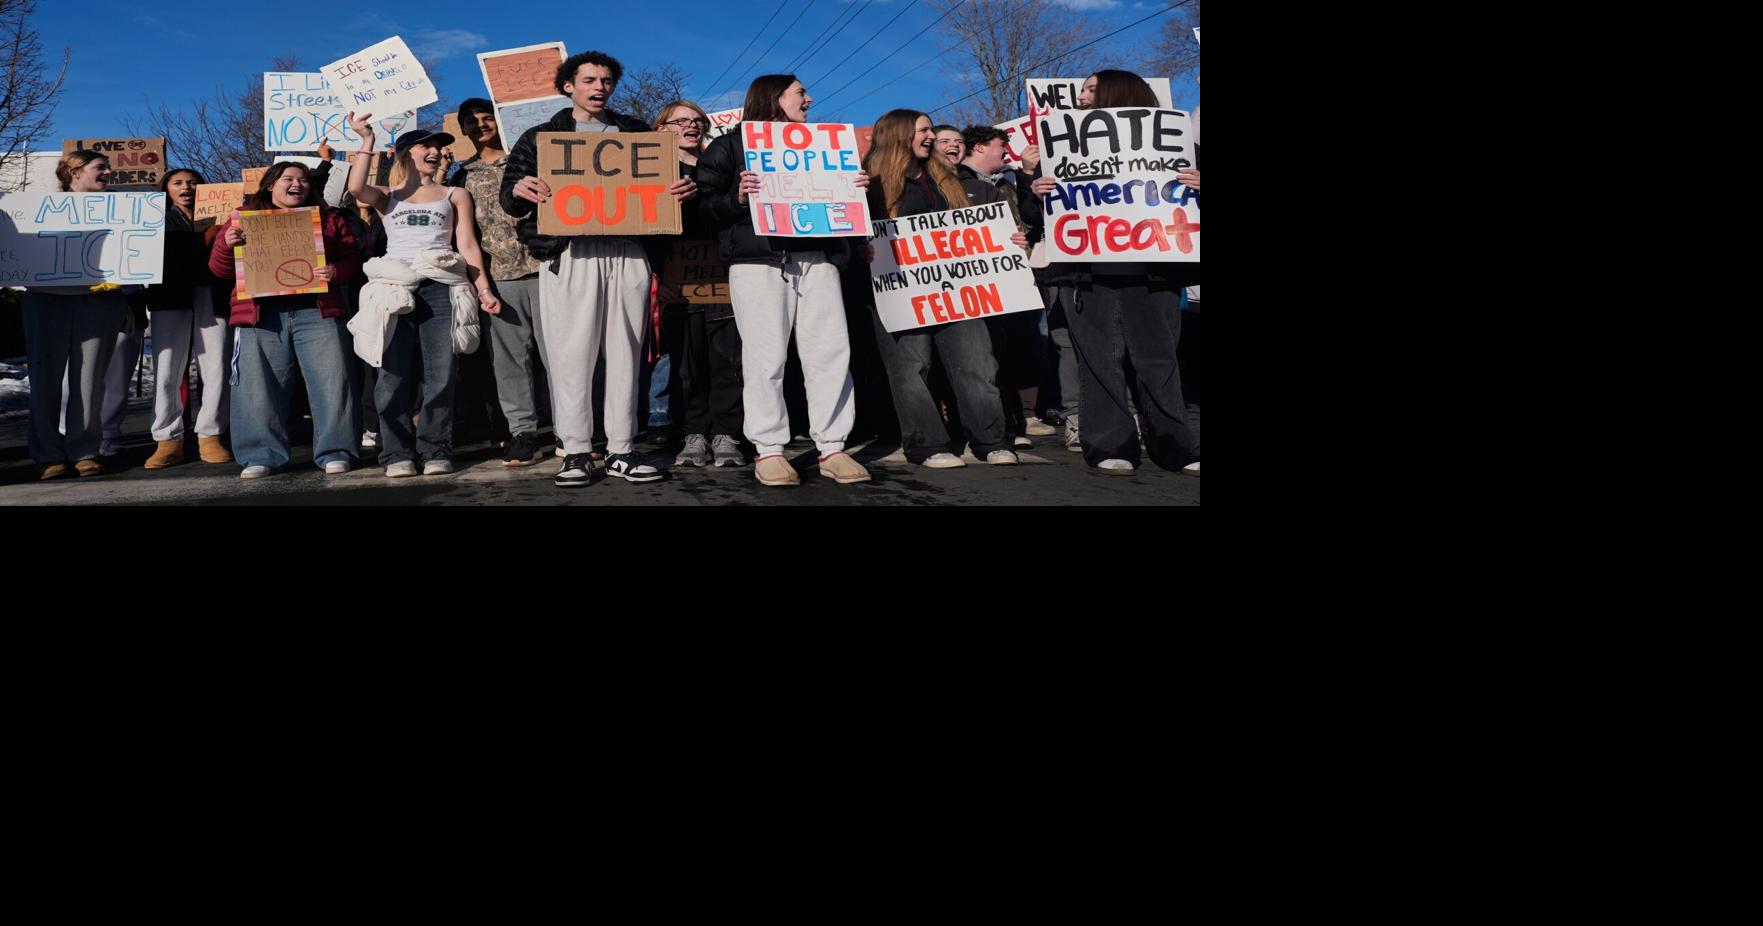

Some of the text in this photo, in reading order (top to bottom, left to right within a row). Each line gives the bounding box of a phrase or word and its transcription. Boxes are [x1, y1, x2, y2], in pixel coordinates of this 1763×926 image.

[269, 74, 296, 91] I
[334, 60, 367, 79] ICE
[353, 88, 376, 105] NOT
[268, 115, 308, 147] NO
[745, 122, 847, 150] HOT
[1040, 109, 1185, 159] HATE
[117, 152, 160, 167] NO
[551, 138, 661, 178] ICE
[745, 149, 858, 172] PEOPLE
[1054, 156, 1191, 179] doesn't make
[109, 170, 157, 185] RDERS
[35, 191, 166, 228] MELTS
[196, 202, 234, 215] MELTS
[197, 189, 232, 203] LOVE
[554, 184, 665, 226] OUT
[763, 203, 854, 234] ICE
[867, 203, 1005, 241] ON'T TALK ABOUT
[1054, 207, 1200, 256] Great
[34, 229, 158, 281] ICE
[890, 226, 1004, 266] ILLEGAL
[872, 254, 1027, 293] WHEN YOU VOTED FOR
[941, 281, 954, 291] A
[911, 283, 1003, 325] FELON
